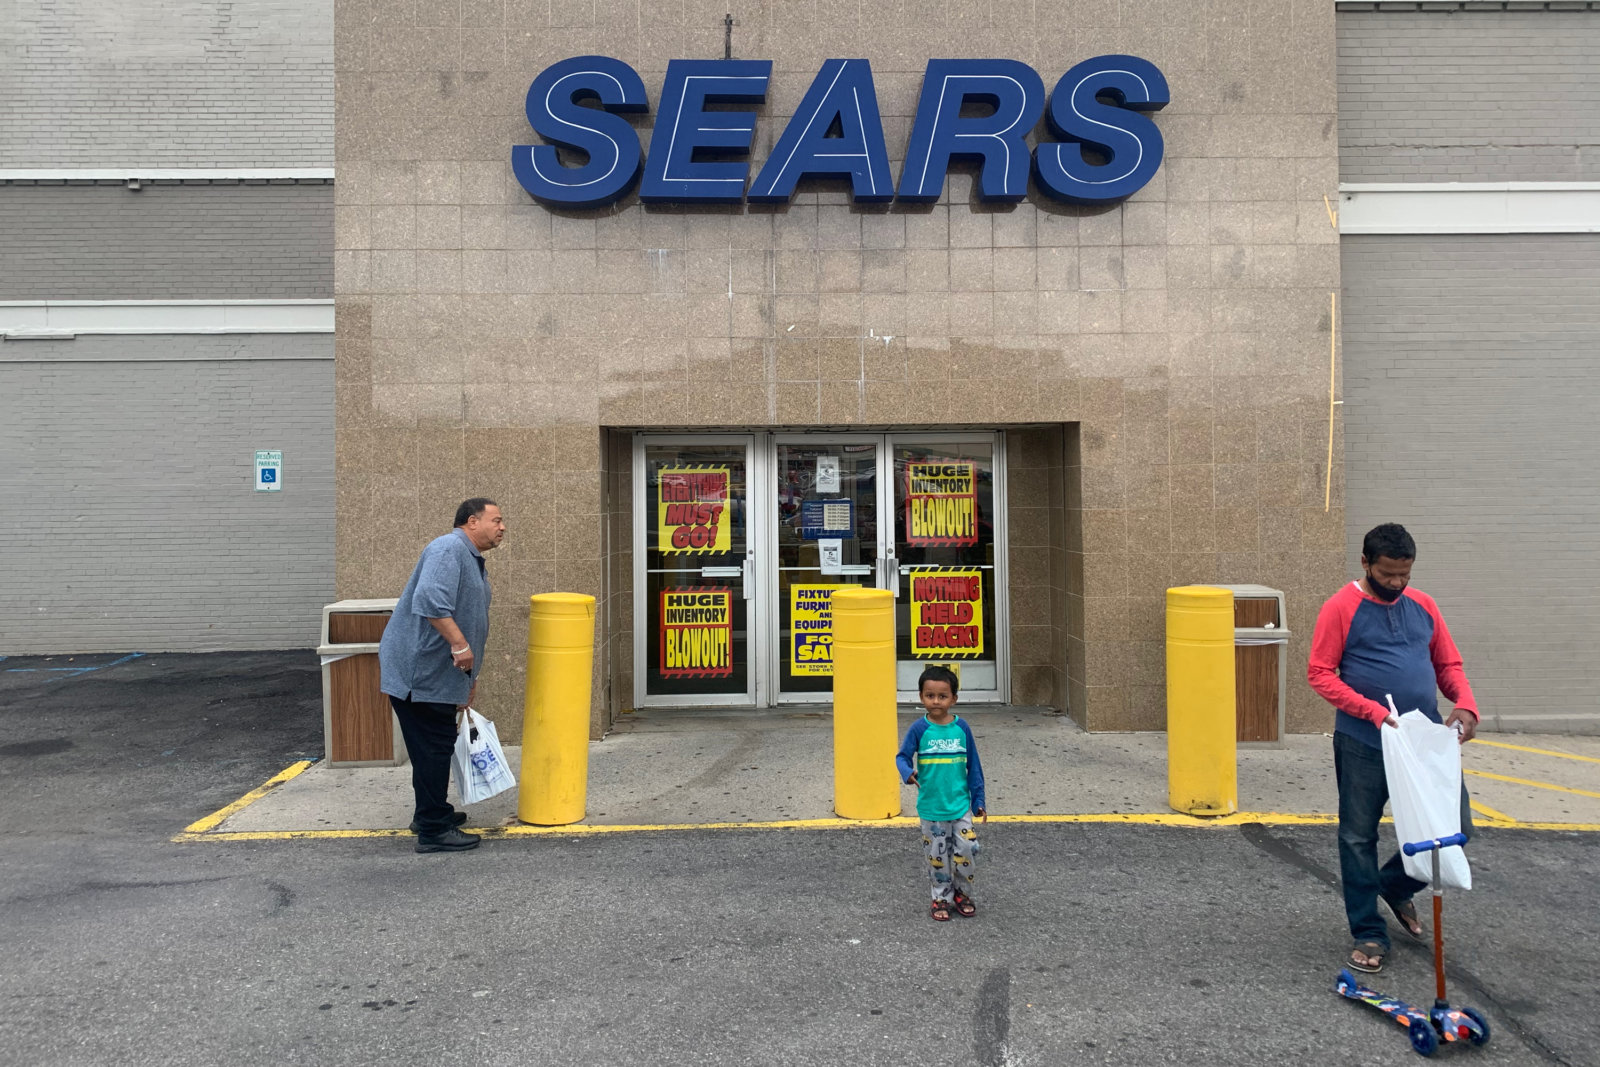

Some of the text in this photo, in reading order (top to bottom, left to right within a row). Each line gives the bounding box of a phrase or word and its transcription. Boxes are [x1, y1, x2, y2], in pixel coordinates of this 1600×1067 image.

[512, 55, 1170, 203] SEARS
[913, 465, 969, 477] HUGE
[911, 479, 970, 493] INVENTORY
[664, 503, 724, 526] MUST
[911, 497, 974, 538] BLOWOUT!
[671, 526, 718, 549] GO!
[914, 576, 980, 602] NOTHING
[668, 595, 725, 606] HUGE
[796, 602, 832, 610] FURNI
[666, 608, 726, 623] INVENTORY
[921, 603, 973, 625] HELD
[806, 635, 833, 644] FO
[916, 625, 979, 648] BACK!
[665, 626, 729, 670] BLOWOUT!
[798, 645, 833, 660] SA
